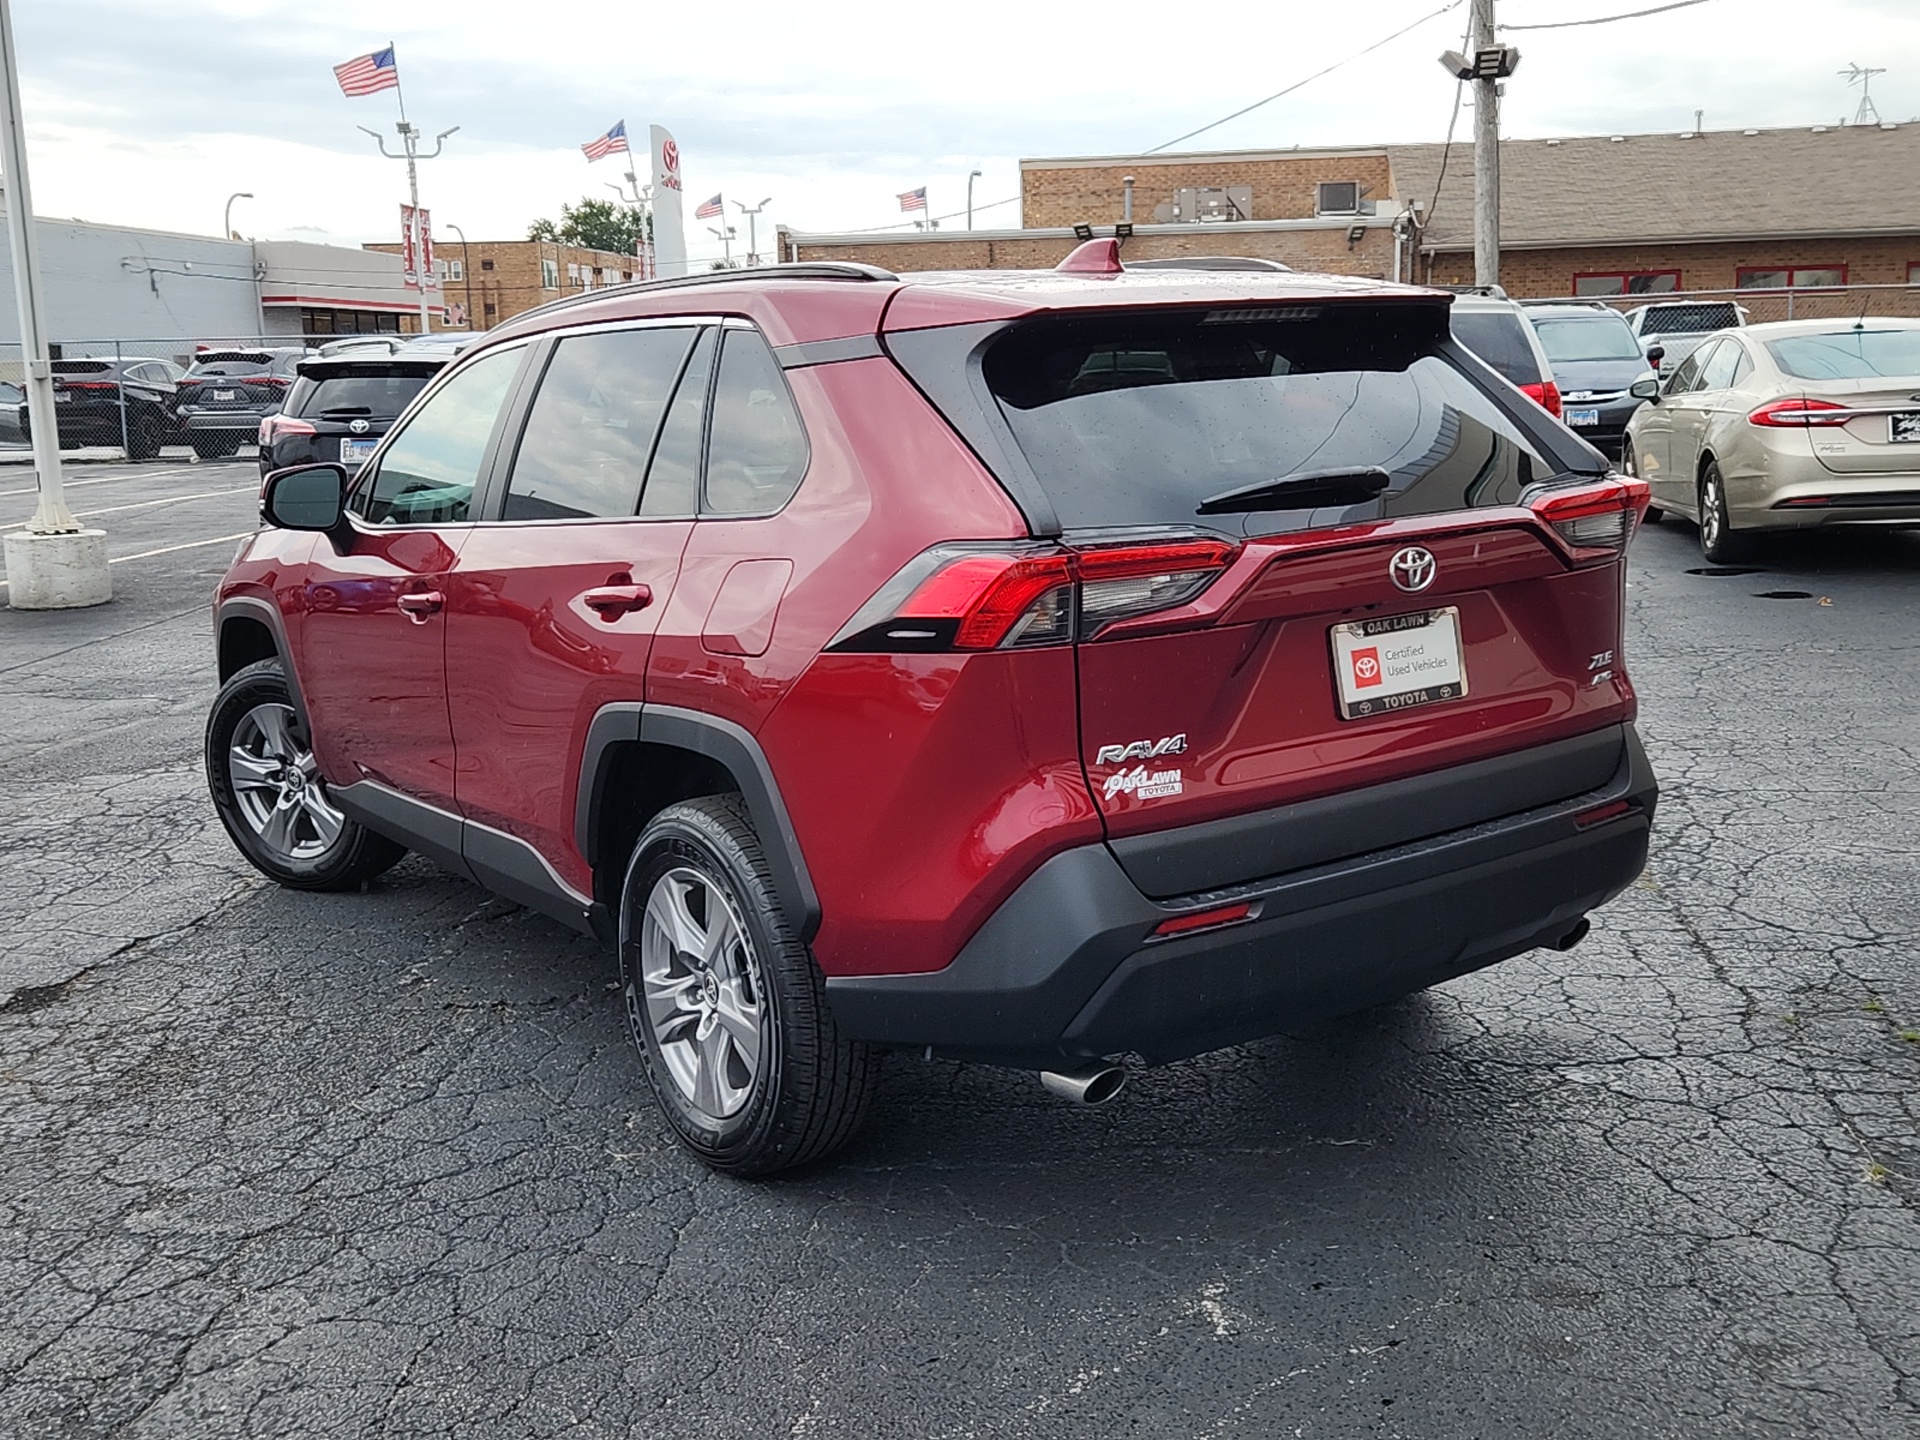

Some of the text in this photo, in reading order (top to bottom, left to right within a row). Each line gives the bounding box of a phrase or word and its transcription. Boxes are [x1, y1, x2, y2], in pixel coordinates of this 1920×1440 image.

[1366, 613, 1425, 634] OAK LAWN
[1385, 643, 1425, 661] Certified
[1387, 657, 1448, 677] Used Vehicles
[1382, 690, 1429, 709] TOYOTA
[1095, 733, 1188, 765] RAV4
[1142, 784, 1177, 796] TOYOTA
